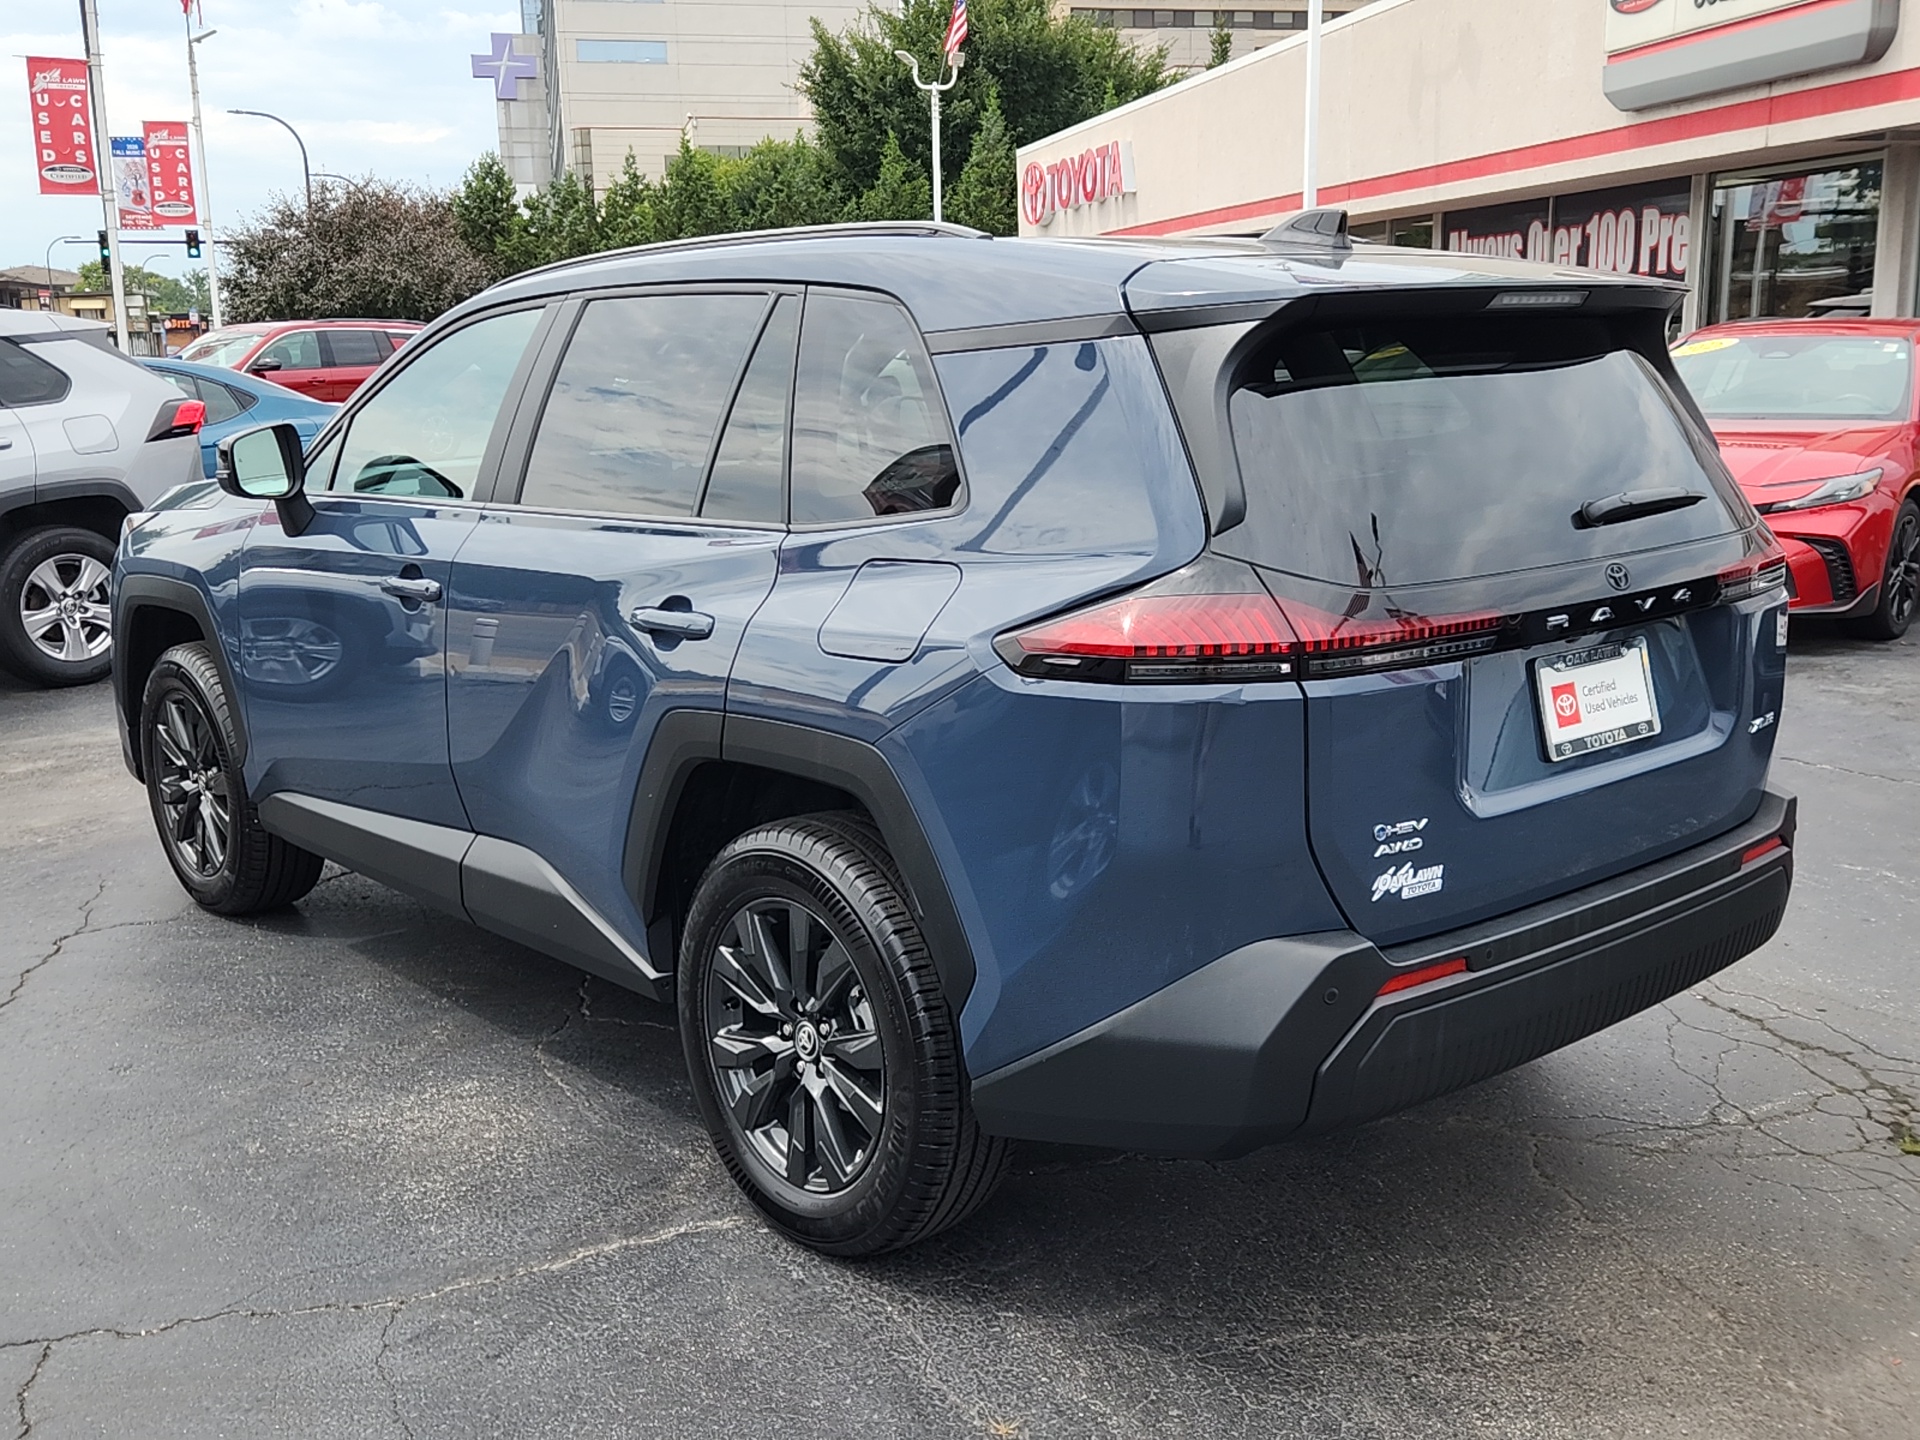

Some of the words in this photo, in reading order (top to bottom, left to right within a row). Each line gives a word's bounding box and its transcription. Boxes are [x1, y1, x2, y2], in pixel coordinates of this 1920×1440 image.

[35, 93, 56, 162] USED
[69, 95, 87, 163] CARS
[149, 148, 165, 201] USED
[175, 148, 189, 201] CARS
[1046, 140, 1124, 212] TOYOTA
[1586, 207, 1636, 274] 100
[1638, 204, 1691, 276] Pre
[1546, 588, 1692, 630] RAV4
[1565, 652, 1589, 666] OAK
[1590, 645, 1619, 661] LAWN
[1582, 678, 1617, 697] Certified
[1584, 700, 1606, 715] Used
[1606, 693, 1639, 710] Vehicles
[1584, 728, 1628, 749] TOYOTA
[1373, 837, 1424, 858] AWD
[1407, 881, 1436, 894] TOYOTA
